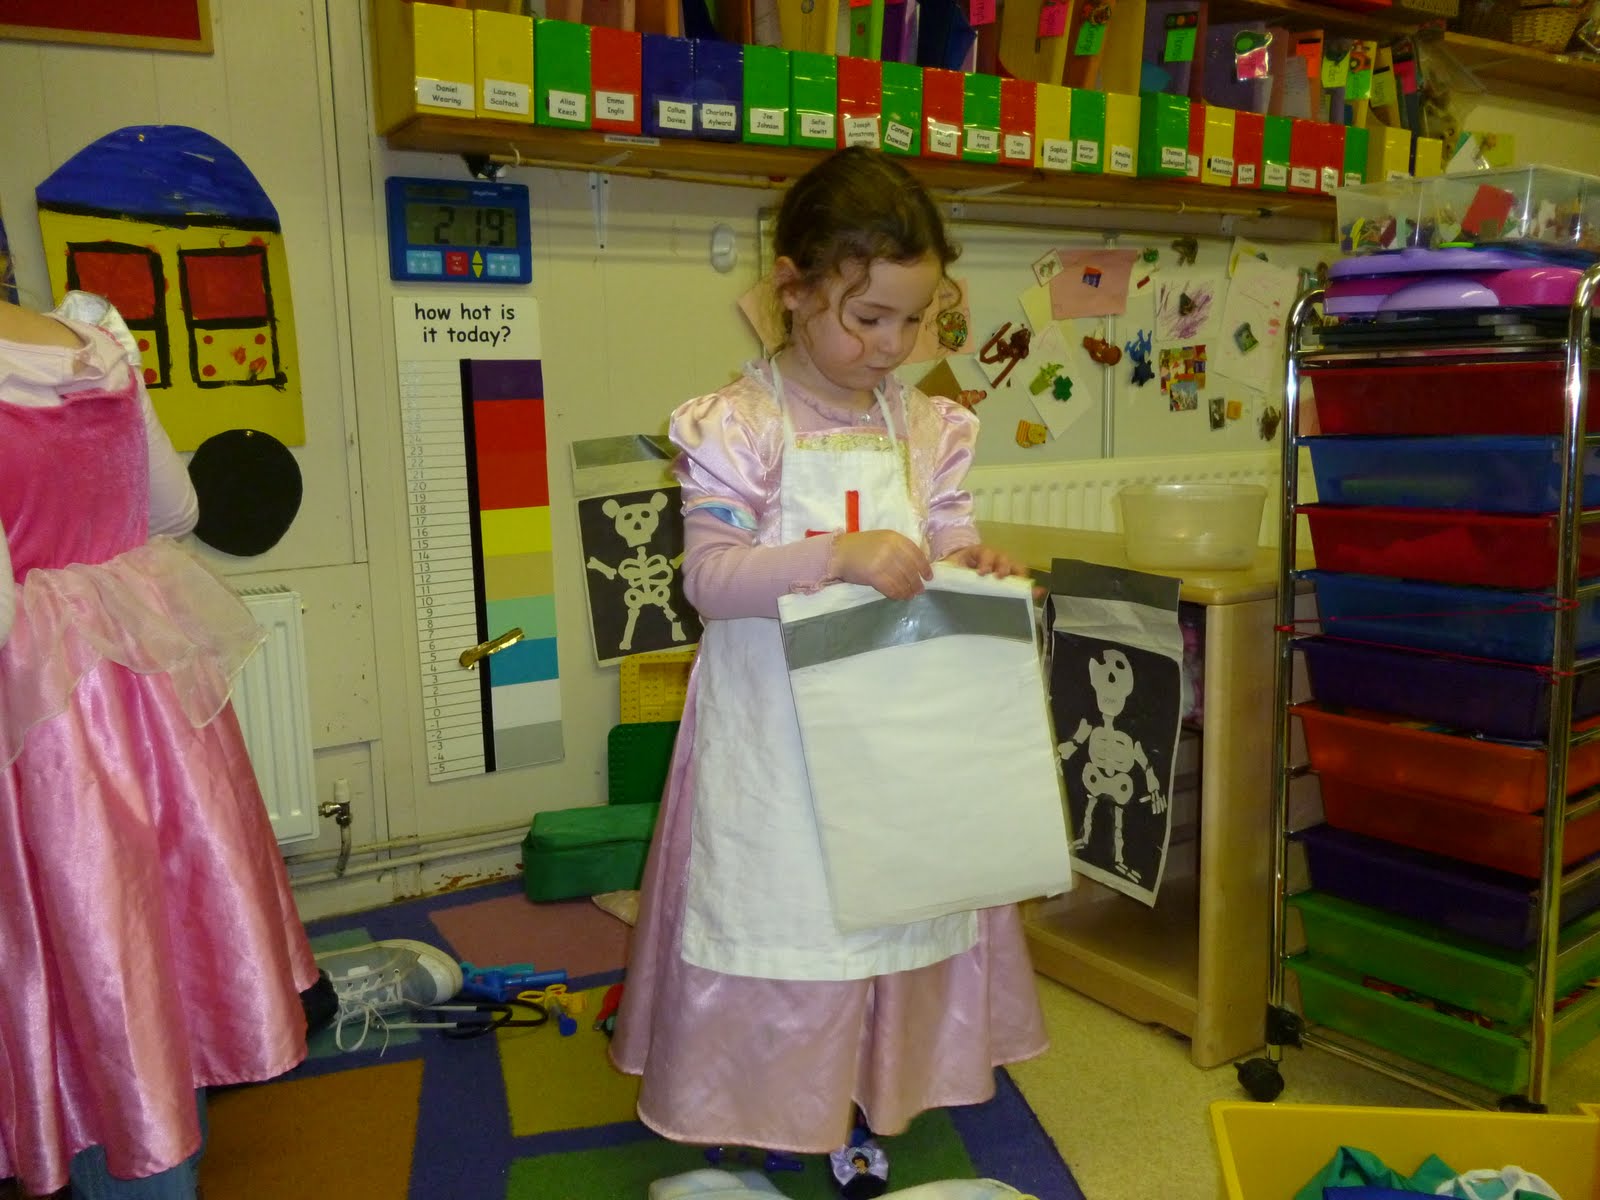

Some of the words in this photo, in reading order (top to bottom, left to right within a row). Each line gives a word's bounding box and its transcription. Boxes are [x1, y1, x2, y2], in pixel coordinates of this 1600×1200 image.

[436, 84, 458, 93] Daniel
[493, 87, 517, 97] Lauren
[432, 94, 462, 107] Wearing
[606, 96, 625, 105] Emma
[607, 107, 625, 116] Inglis
[667, 106, 686, 115] Callum
[705, 108, 733, 117] Charlotte
[666, 116, 686, 125] Davies
[756, 121, 779, 130] Johnson
[890, 124, 910, 138] Connie
[886, 135, 909, 148] Dawson
[415, 303, 451, 320] how
[460, 303, 491, 320] hot
[501, 304, 515, 320] is
[423, 326, 437, 343] it
[447, 325, 511, 347] today?
[410, 446, 424, 456] 23
[413, 470, 424, 479] 21
[413, 481, 427, 491] 20
[414, 493, 426, 503] 19
[415, 504, 427, 514] 18
[416, 516, 427, 525] 17
[417, 528, 429, 537] 16
[417, 540, 429, 549] 15
[418, 551, 430, 560] 14
[419, 562, 430, 572] 13
[421, 574, 432, 583] 12
[421, 585, 430, 594] 11
[421, 596, 433, 606] 10
[426, 608, 433, 617] 9
[427, 619, 434, 629] 8
[427, 630, 434, 639] 7
[428, 641, 436, 650] 6
[430, 652, 437, 661] 5
[430, 664, 437, 672] 4
[431, 674, 438, 684] 3
[432, 686, 439, 695] 2
[433, 708, 441, 717] 0
